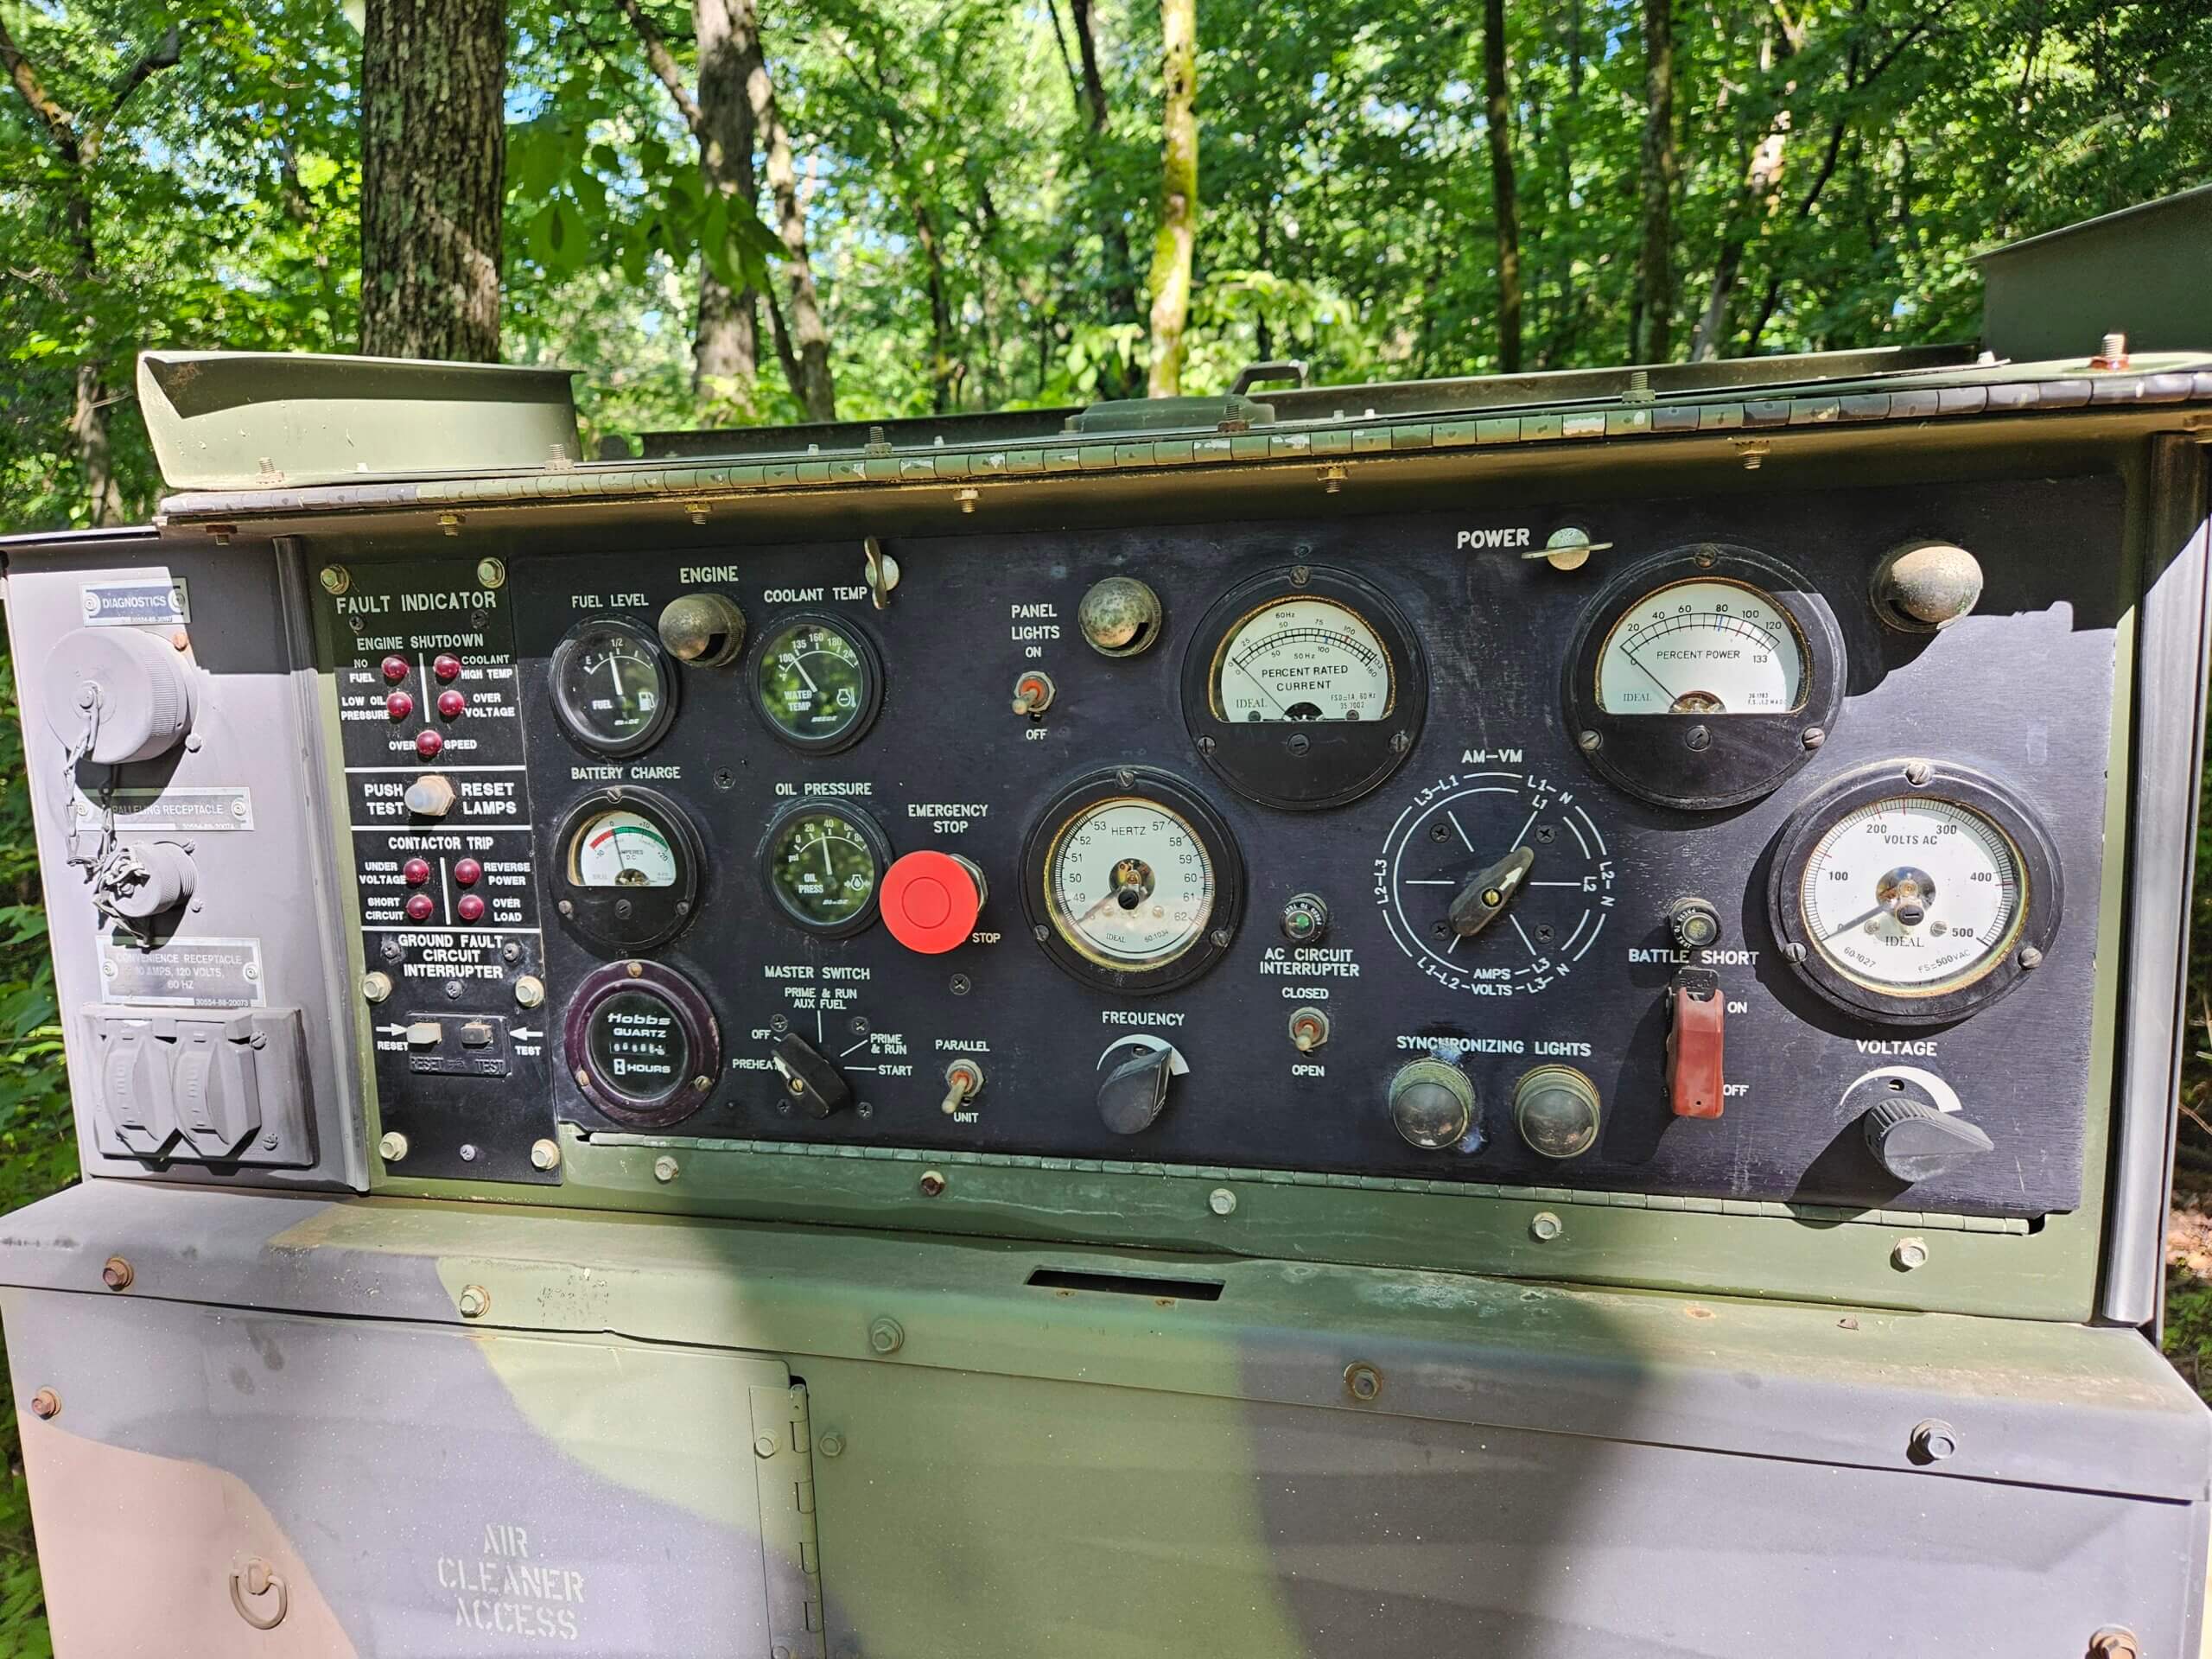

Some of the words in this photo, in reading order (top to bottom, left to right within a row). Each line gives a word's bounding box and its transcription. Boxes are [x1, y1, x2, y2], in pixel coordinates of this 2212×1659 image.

[1458, 528, 1530, 550] POWER
[680, 566, 738, 583] ENGINE
[764, 588, 824, 603] COOLANT
[832, 586, 868, 601] TEMP
[102, 596, 167, 608] DIAGNOSTICS
[336, 595, 391, 614] FAULT
[401, 590, 497, 612] INDICATOR
[572, 594, 603, 608] FUEL
[610, 593, 649, 607] LEVEL
[1011, 605, 1057, 619] PANEL
[1678, 605, 1692, 613] 60
[1716, 604, 1729, 613] 80
[1652, 611, 1665, 620] 40
[1742, 609, 1759, 620] 100
[1279, 620, 1288, 629] 50
[1628, 622, 1640, 632] 20
[1765, 620, 1782, 631] 120
[808, 632, 824, 643] 160
[1012, 626, 1060, 640] LIGHTS
[357, 636, 404, 651] ENGINE
[410, 633, 484, 649] SHUTDOWN
[611, 637, 624, 648] 1/2
[791, 639, 807, 651] 135
[827, 636, 842, 647] 180
[1025, 645, 1042, 658] ON
[1271, 650, 1281, 658] 50
[1317, 645, 1330, 654] 100
[1656, 650, 1701, 660] PERCENT
[1706, 649, 1740, 659] POWER
[353, 659, 368, 668] NO
[461, 654, 511, 665] COOLANT
[585, 655, 592, 665] E
[778, 653, 794, 664] 100
[1753, 654, 1768, 664] 133
[461, 669, 483, 681] HIGH
[486, 669, 513, 680] TEMP
[1262, 668, 1310, 678] PERCENT
[1313, 665, 1348, 676] RATED
[348, 673, 375, 683] FUEL
[1277, 680, 1332, 692] CURRENT
[473, 693, 501, 703] OVER
[785, 690, 812, 700] WATER
[1624, 692, 1652, 702] IDEAL
[341, 696, 365, 707] LOW
[370, 696, 386, 706] OIL
[592, 700, 613, 709] FUEL
[789, 701, 811, 711] TEMP
[1236, 697, 1268, 709] IDEAL
[340, 709, 391, 721] PRESSURE
[464, 707, 516, 719] VOLTAGE
[1026, 728, 1047, 741] OFF
[389, 741, 416, 751] OVER
[444, 740, 477, 750] SPEED
[571, 767, 624, 781] BATTERY
[631, 766, 681, 780] CHARGE
[365, 784, 404, 798] PUSH
[461, 783, 514, 797] RESET
[775, 784, 800, 797] OIL
[804, 783, 872, 796] PRESSURE
[1532, 794, 1548, 810] L1
[163, 804, 225, 816] RECEPTACLE
[366, 802, 404, 816] TEST
[463, 801, 517, 815] LAMPS
[908, 804, 988, 817] EMERGENCY
[804, 823, 816, 833] 20
[823, 819, 835, 829] 40
[933, 820, 969, 834] STOP
[1094, 822, 1106, 831] 53
[1152, 821, 1165, 831] 57
[1866, 824, 1887, 835] 200
[1111, 826, 1147, 836] HERTZ
[1936, 824, 1957, 836] 300
[388, 836, 461, 850] CONTACTOR
[467, 836, 493, 850] TRIP
[1080, 836, 1091, 846] 52
[1169, 836, 1182, 847] 58
[1884, 835, 1919, 845] VOLTS
[1923, 836, 1938, 846] AC
[1071, 853, 1083, 862] 51
[1179, 854, 1192, 864] 59
[365, 861, 398, 872] UNDER
[484, 862, 531, 873] REVERSE
[359, 874, 407, 886] VOLTAGE
[488, 876, 526, 886] POWER
[804, 873, 818, 883] OIL
[1069, 873, 1082, 883] 50
[1184, 873, 1198, 883] 60
[1828, 872, 1848, 881] 100
[1970, 872, 1992, 882] 400
[1583, 874, 1597, 893] L2
[798, 885, 824, 894] PRESS
[368, 897, 400, 907] SHORT
[1073, 893, 1086, 902] 49
[1183, 893, 1195, 902] 61
[493, 899, 521, 908] OVER
[365, 911, 404, 922] CIRCUIT
[494, 912, 522, 922] LOAD
[1174, 912, 1188, 921] 62
[972, 932, 1001, 944] STOP
[1951, 928, 1974, 938] 500
[398, 934, 454, 948] GROUND
[461, 935, 503, 949] FAULT
[1885, 935, 1925, 948] IDEAL
[117, 953, 179, 964] CONVENIENCE
[184, 954, 242, 965] RECEPTACLE
[423, 950, 480, 963] CIRCUIT
[1264, 948, 1285, 961] AC
[1294, 949, 1353, 963] CIRCUIT
[1628, 949, 1689, 963] BATTLE
[1701, 950, 1759, 965] SHORT
[176, 967, 191, 977] 120
[193, 967, 225, 979] VOLTS,
[404, 964, 504, 979] INTERRUPTER
[765, 966, 814, 979] MASTER
[822, 967, 871, 981] SWITCH
[1260, 962, 1359, 977] INTERRUPTER
[1473, 969, 1510, 980] AMPS
[167, 979, 180, 989] 60
[181, 980, 194, 989] HZ
[785, 987, 816, 998] PRIME
[822, 988, 831, 998] &
[835, 988, 857, 999] RUN
[1281, 987, 1329, 1000] CLOSED
[1471, 984, 1513, 996] VOLTS
[793, 999, 815, 1009] AUX
[820, 1000, 847, 1010] FUEL
[1727, 1001, 1747, 1014] ON
[607, 1012, 671, 1026] Hobbs
[1102, 1011, 1185, 1026] FREQUENCY
[613, 1027, 667, 1038] QUARTZ
[752, 1029, 772, 1040] OFF
[870, 1033, 902, 1045] PRIME
[377, 1041, 409, 1052] RESET
[515, 1046, 541, 1056] TEST
[871, 1044, 880, 1054] &
[884, 1044, 907, 1055] RUN
[935, 1039, 990, 1052] PARALLEL
[1396, 1035, 1524, 1054] SYNCHRONIZING
[1535, 1041, 1591, 1057] LIGHTS
[1857, 1040, 1937, 1057] VOLTAGE
[626, 1063, 671, 1074] HOURS
[878, 1065, 913, 1077] START
[1292, 1065, 1325, 1077] OPEN
[1723, 1084, 1749, 1097] OFF
[954, 1112, 979, 1124] UNIT
[483, 1523, 528, 1558] AIR
[436, 1556, 584, 1604] CLEANER
[456, 1596, 579, 1640] ACCESS
